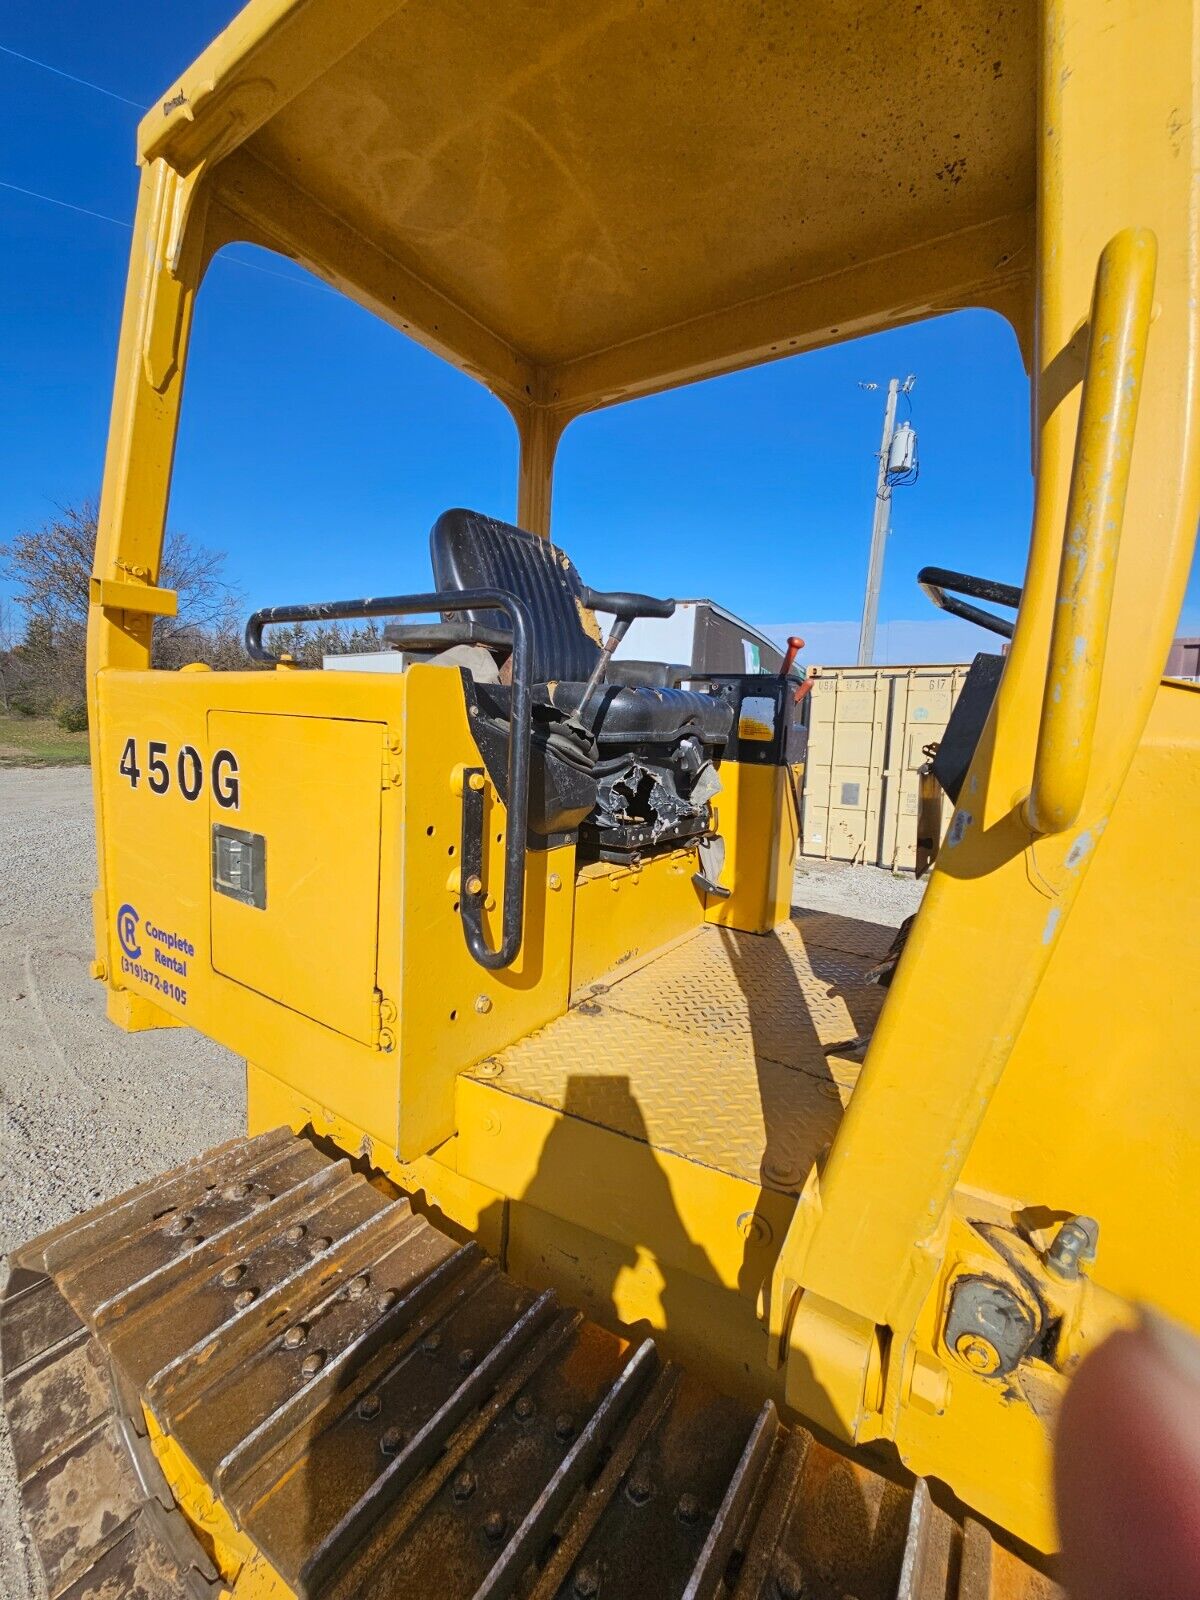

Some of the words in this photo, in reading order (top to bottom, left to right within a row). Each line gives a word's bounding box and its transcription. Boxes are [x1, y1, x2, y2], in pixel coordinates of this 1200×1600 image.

[929, 678, 946, 690] 617
[120, 738, 240, 809] 450G
[145, 920, 195, 957] Complete
[154, 947, 187, 977] Rental
[121, 956, 187, 1006] (319)372-8105
